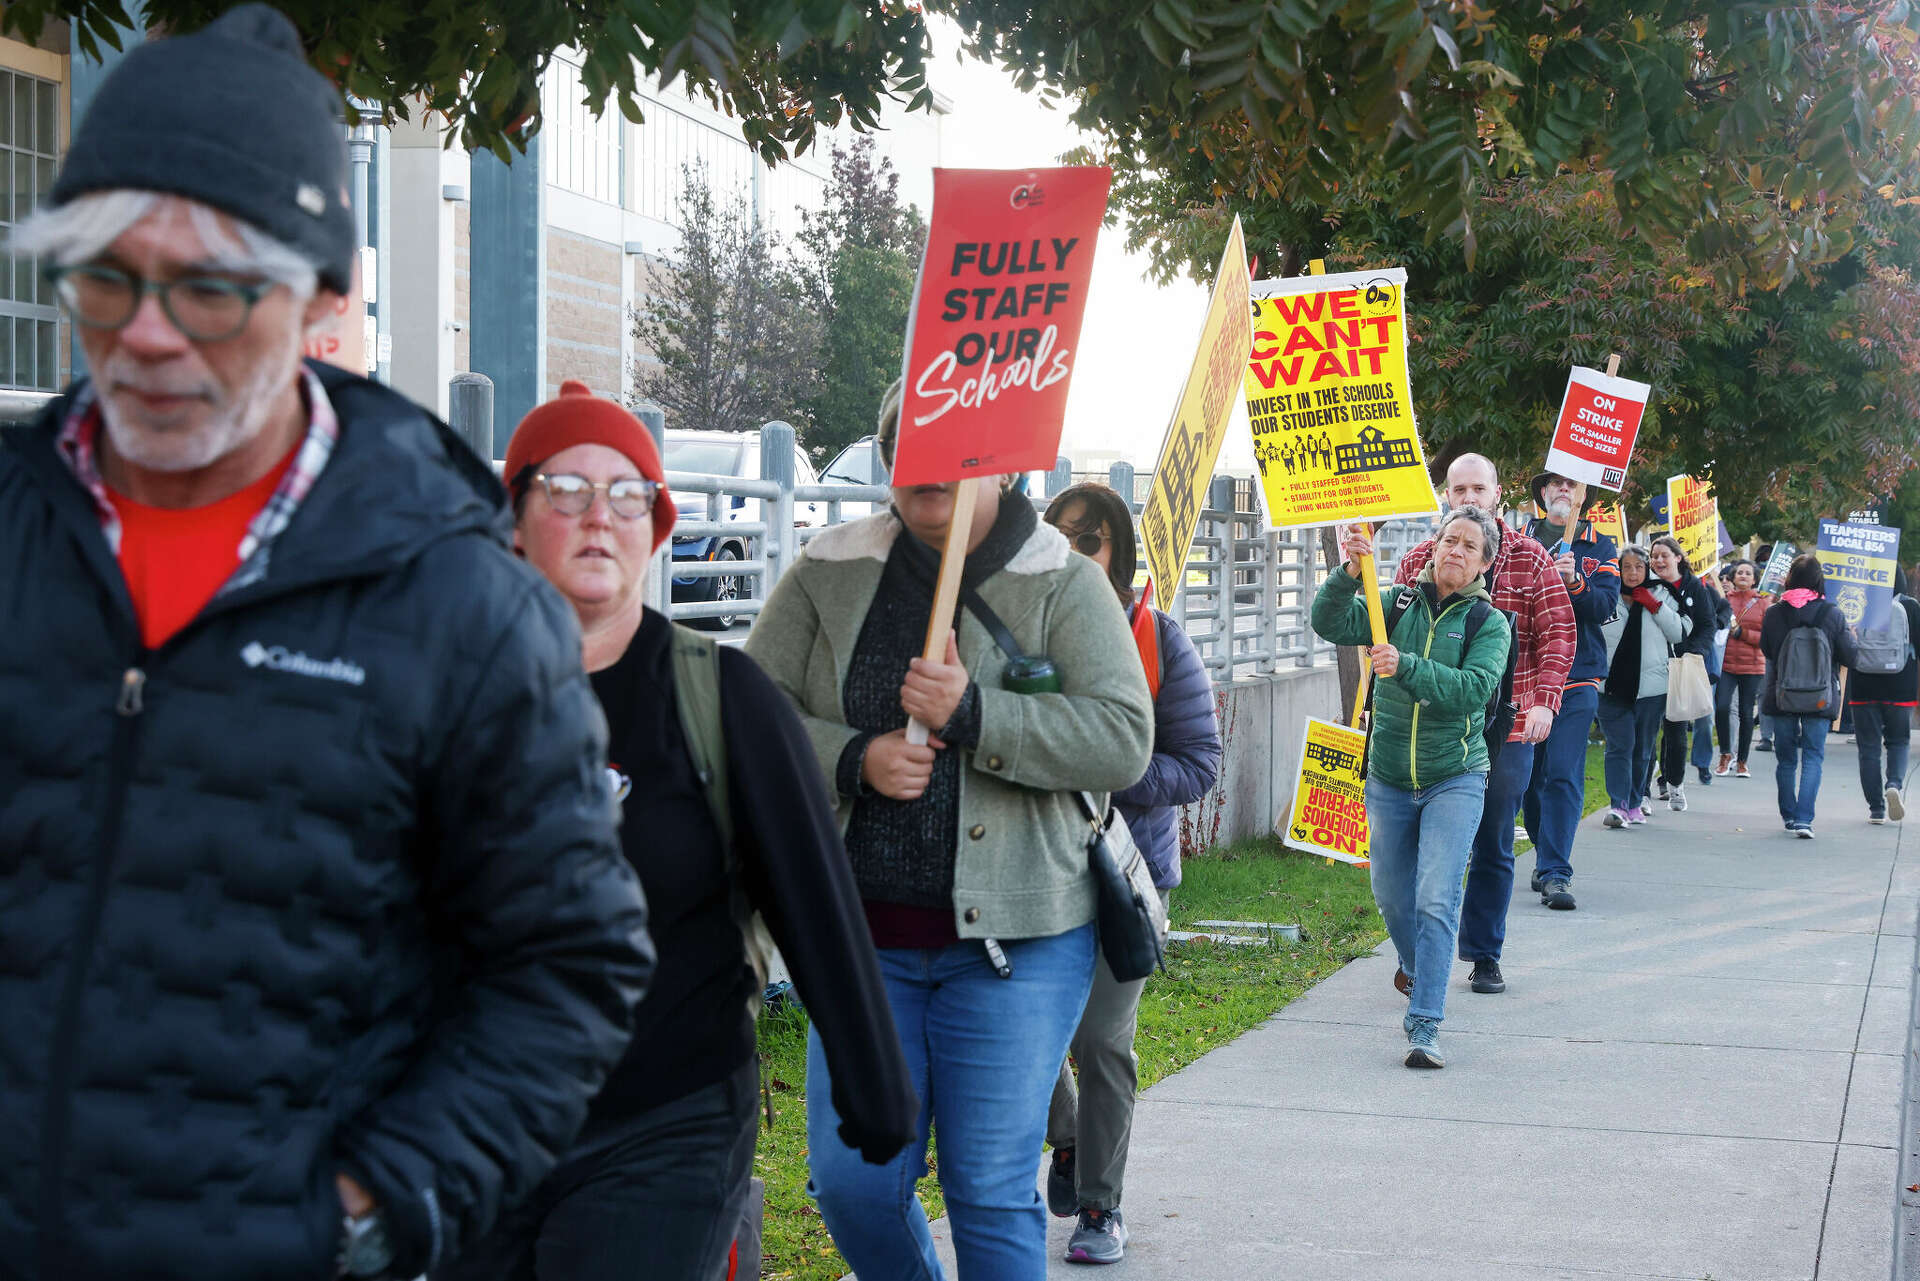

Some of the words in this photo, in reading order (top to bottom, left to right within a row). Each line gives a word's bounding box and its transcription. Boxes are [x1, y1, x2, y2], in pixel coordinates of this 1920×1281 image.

[950, 237, 1078, 277] FULLY
[941, 283, 1070, 323] STAFF
[1272, 290, 1361, 326] WE
[955, 328, 1042, 367] OUR
[1250, 315, 1397, 360] CAN'T
[914, 324, 1069, 427] Schools
[1248, 346, 1389, 389] WAIT
[1247, 394, 1292, 417] INVEST
[1296, 392, 1311, 409] IN
[1314, 387, 1340, 405] THE
[1343, 382, 1394, 402] SCHOOLS
[1593, 396, 1616, 412] ON
[1251, 415, 1279, 436] OUR
[1282, 405, 1349, 430] STUDENTS
[1352, 401, 1401, 424] DESERVE
[1577, 407, 1624, 432] STRIKE
[1569, 433, 1594, 448] CLASS
[1594, 442, 1618, 455] SIZES
[1570, 422, 1586, 434] FOR
[1586, 429, 1622, 446] SMALLER
[1290, 483, 1310, 491] FULLY
[1312, 478, 1340, 489] STAFFED
[1342, 473, 1371, 485] SCHOOLS
[1604, 469, 1621, 483] UTR
[1290, 491, 1322, 502] STABILITY
[1323, 489, 1337, 498] FOR
[1339, 487, 1352, 496] OUR
[1354, 484, 1384, 495] STUDENTS
[1293, 504, 1314, 513] LIVING
[1316, 500, 1338, 510] WAGES
[1339, 498, 1353, 507] FOR
[1355, 494, 1390, 506] EDUCATORS
[1822, 523, 1897, 543] TEAMSTERS
[1830, 535, 1863, 550] LOCAL
[1864, 540, 1885, 552] 856
[1821, 562, 1889, 583] STRIKE
[1847, 556, 1865, 566] ON
[264, 645, 365, 686] Columbia
[1307, 786, 1367, 823] ESPERAR
[1301, 804, 1367, 843] PODEMOS
[1312, 827, 1356, 854] NO
